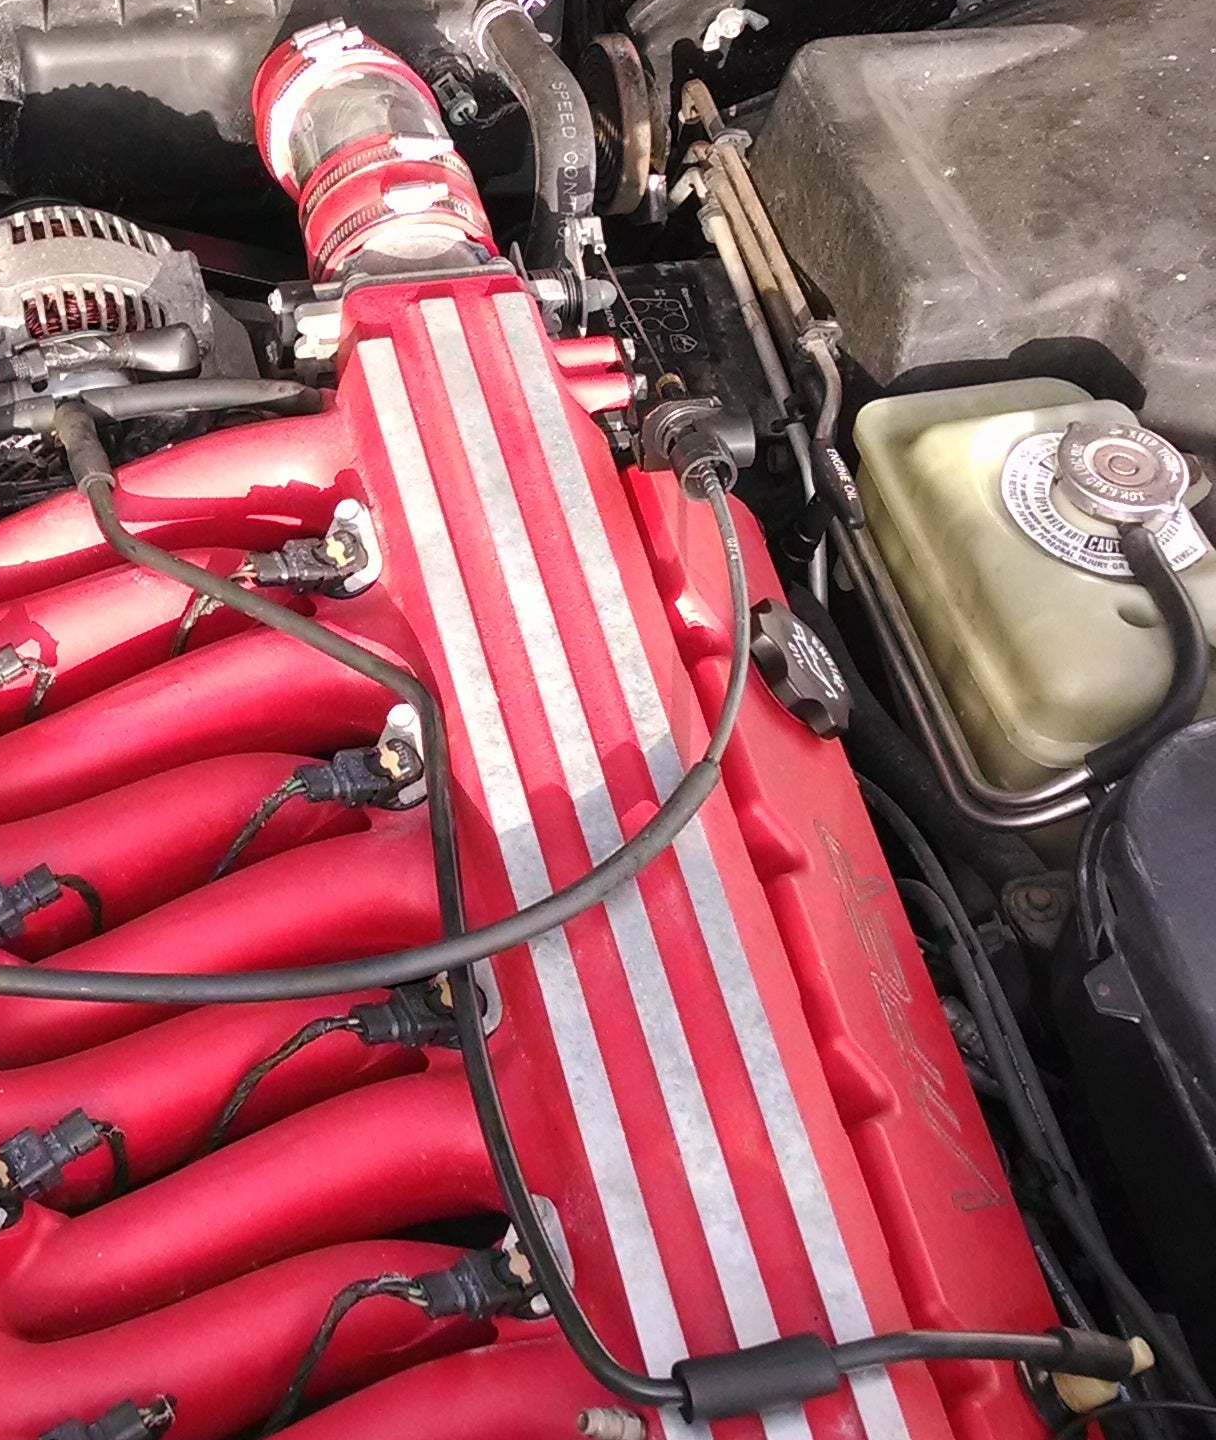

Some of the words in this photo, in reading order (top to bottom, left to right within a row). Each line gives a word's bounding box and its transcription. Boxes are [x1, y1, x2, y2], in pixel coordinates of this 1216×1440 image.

[551, 80, 577, 141] SPEED
[825, 447, 851, 483] ENGINE
[843, 483, 859, 501] OIL
[1034, 496, 1050, 514] OPEN
[1043, 513, 1067, 532] WHEN
[1036, 531, 1075, 558] PERSONAL
[1077, 554, 1107, 568] INJURY
[1088, 535, 1121, 553] CAUT
[786, 641, 805, 670] OIL
